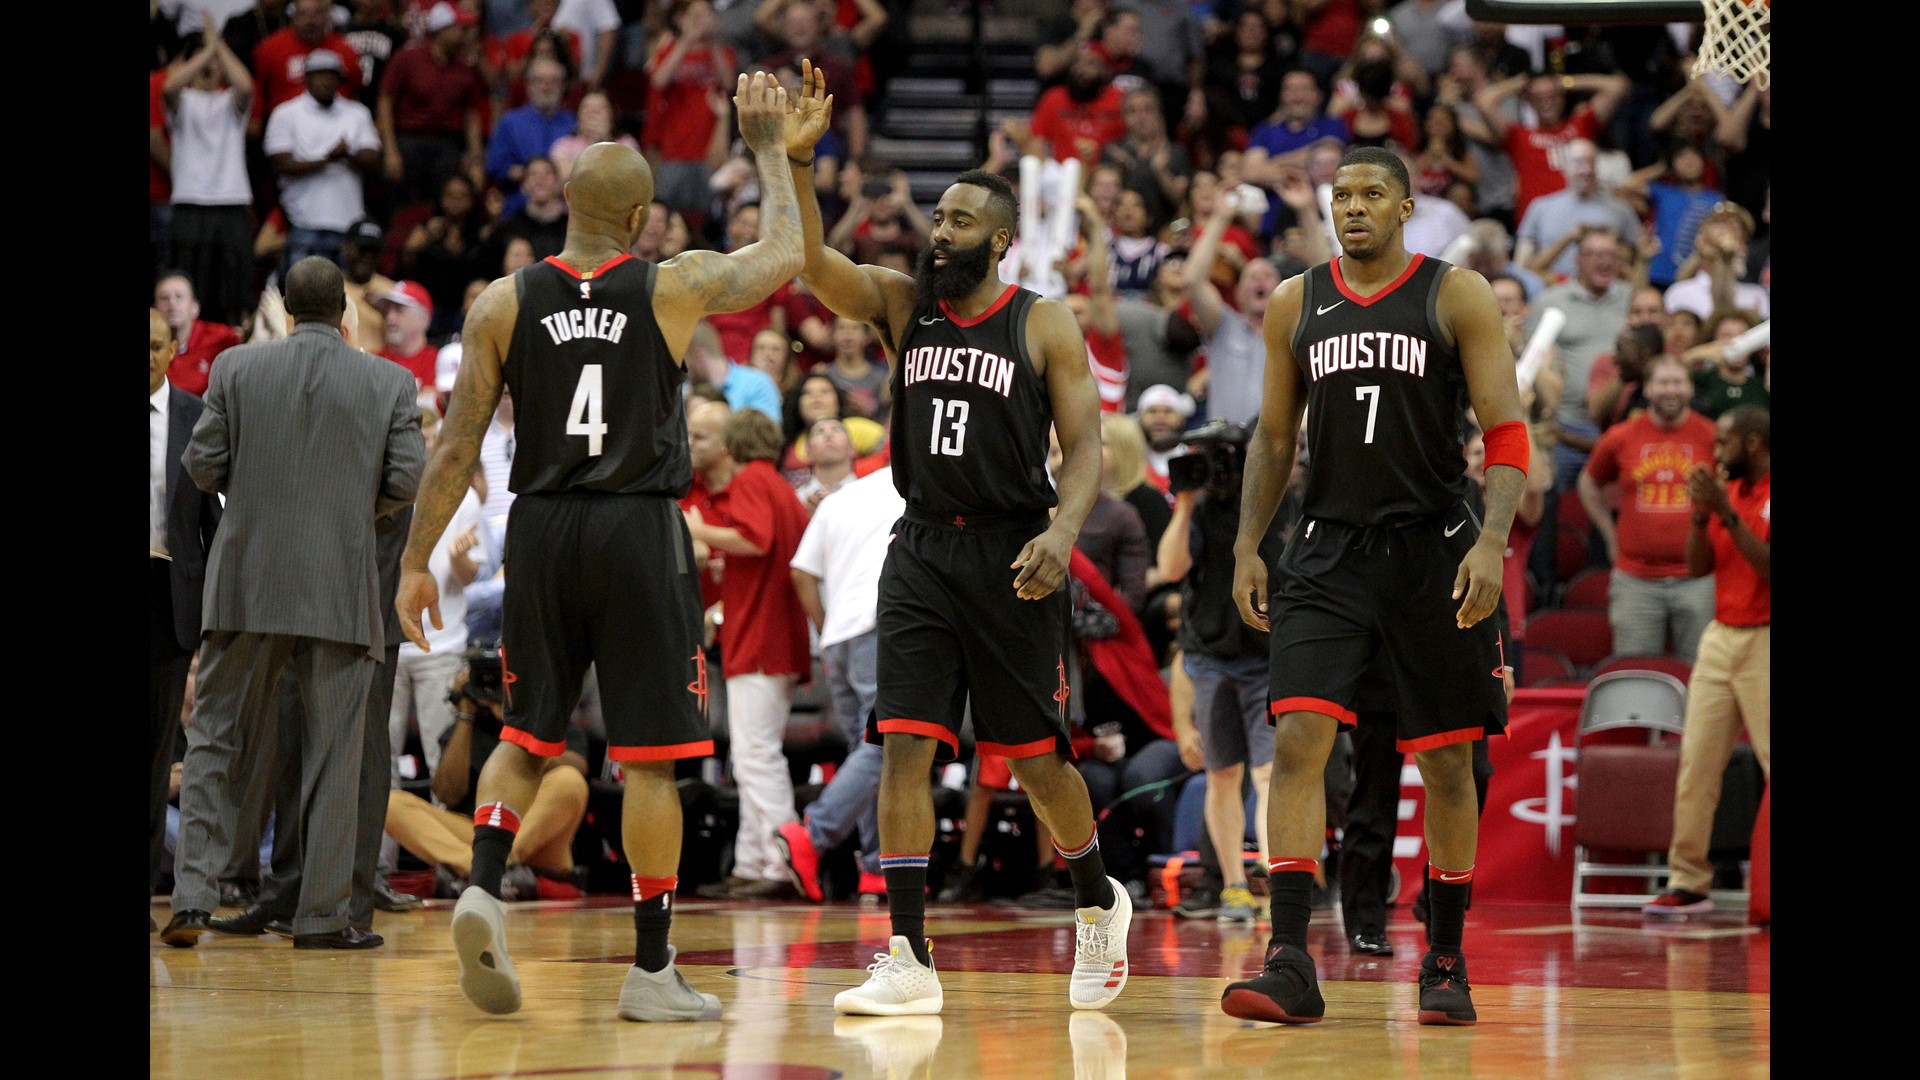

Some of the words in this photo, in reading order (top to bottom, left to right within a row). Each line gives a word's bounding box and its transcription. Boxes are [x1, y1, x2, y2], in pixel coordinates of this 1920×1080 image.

[540, 307, 628, 346] TUCKER
[904, 346, 1015, 398] HOUSTON
[1309, 332, 1427, 382] HOUSTON
[566, 364, 608, 457] 4
[930, 398, 970, 457] 13
[1355, 385, 1381, 444] 7
